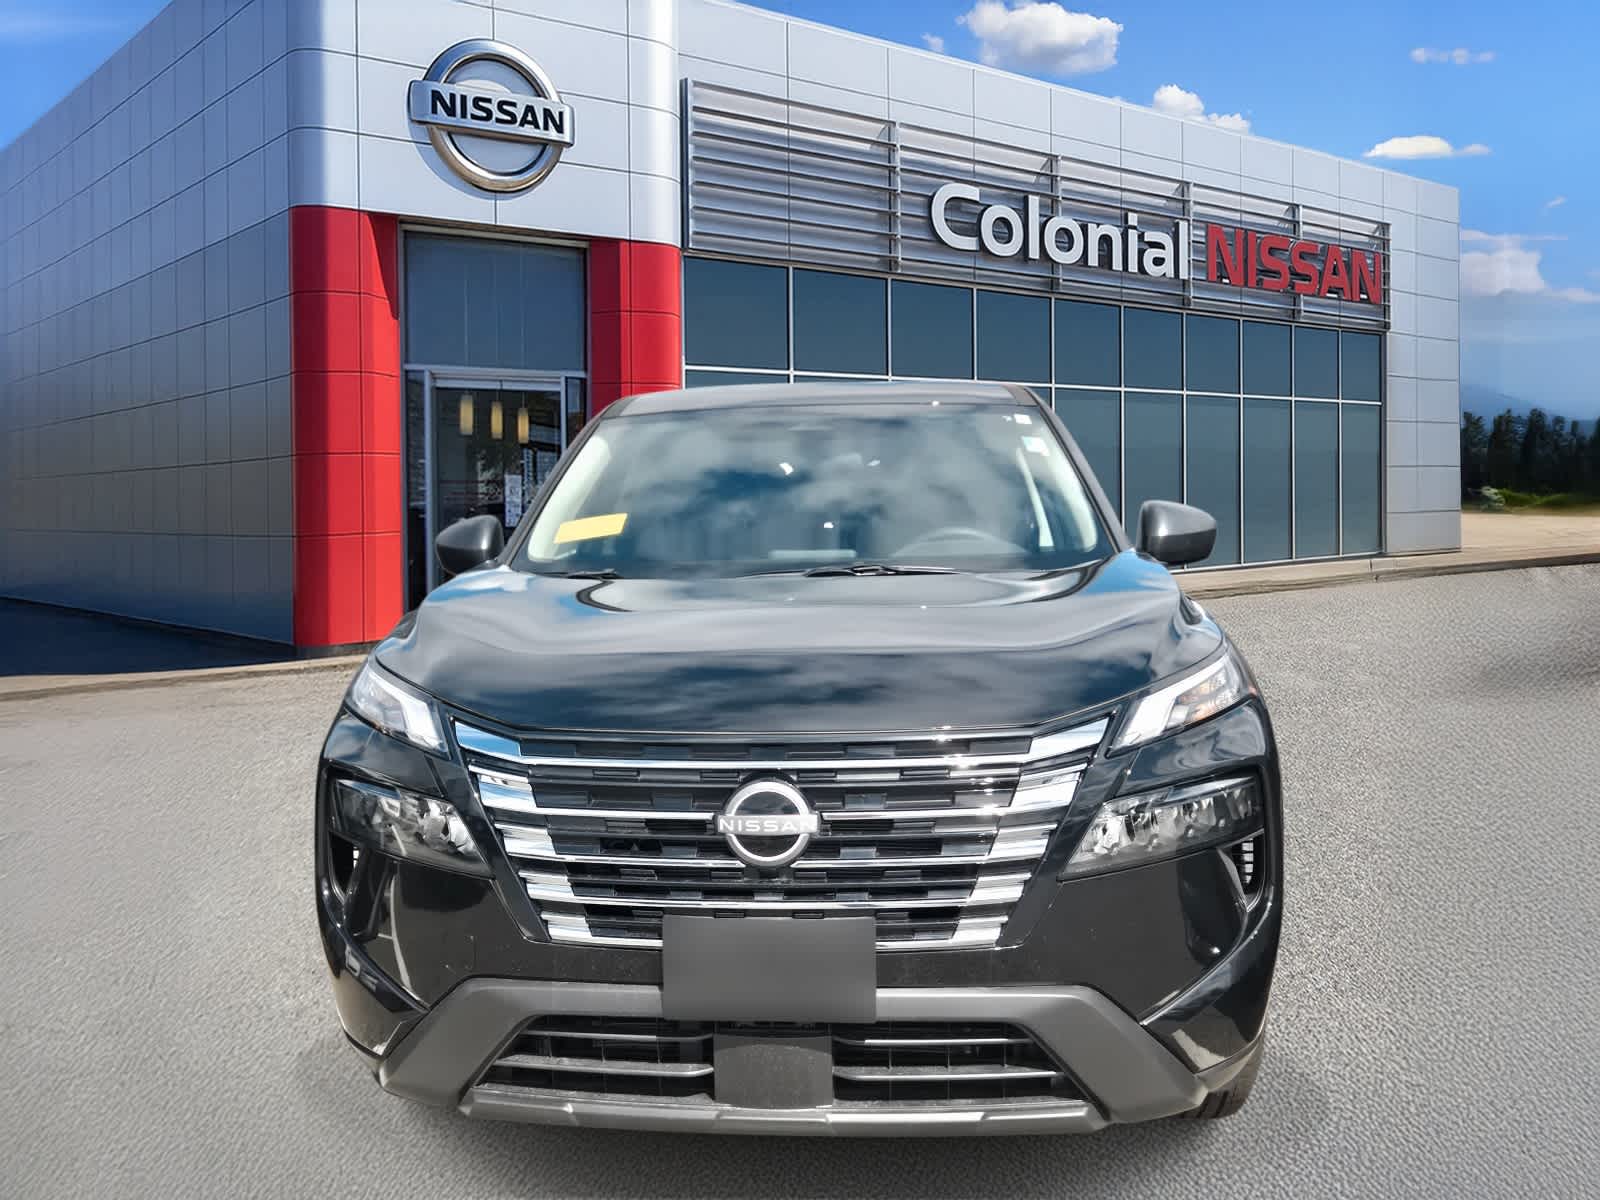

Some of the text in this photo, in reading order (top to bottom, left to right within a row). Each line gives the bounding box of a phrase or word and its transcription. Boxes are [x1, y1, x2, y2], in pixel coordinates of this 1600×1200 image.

[430, 89, 564, 134] NISSAN
[930, 183, 1383, 304] Colonial NISSAN
